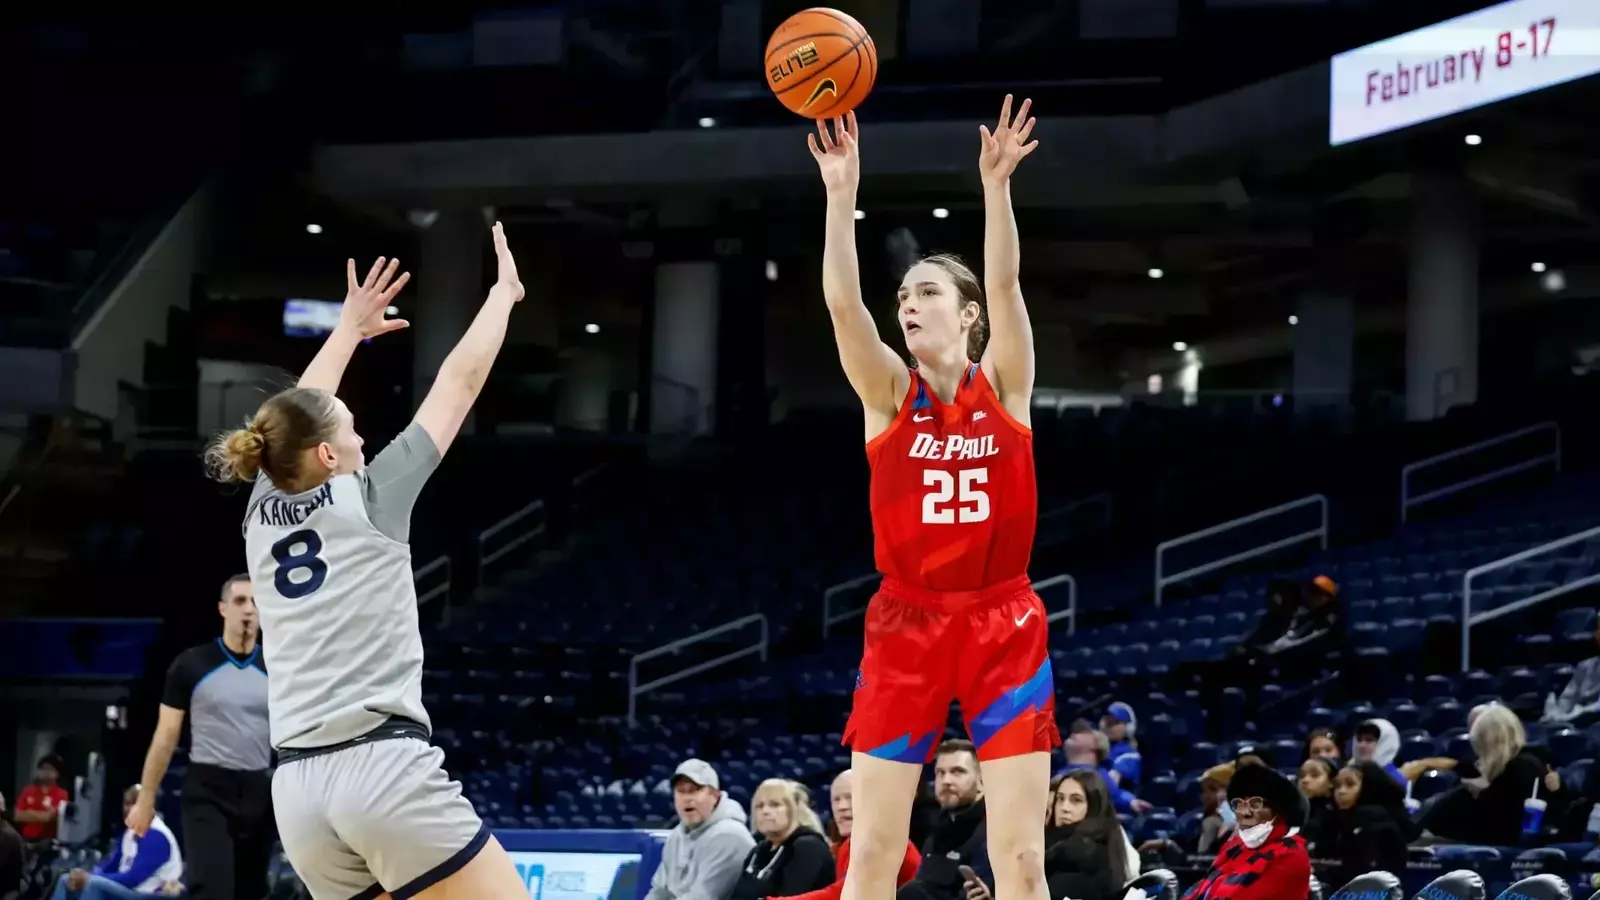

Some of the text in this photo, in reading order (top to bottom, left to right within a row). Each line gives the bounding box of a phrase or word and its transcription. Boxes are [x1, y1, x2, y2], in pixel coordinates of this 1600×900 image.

[770, 48, 819, 83] ELITE
[1366, 17, 1556, 106] February 8-17
[922, 467, 990, 524] 25
[271, 529, 328, 599] 8
